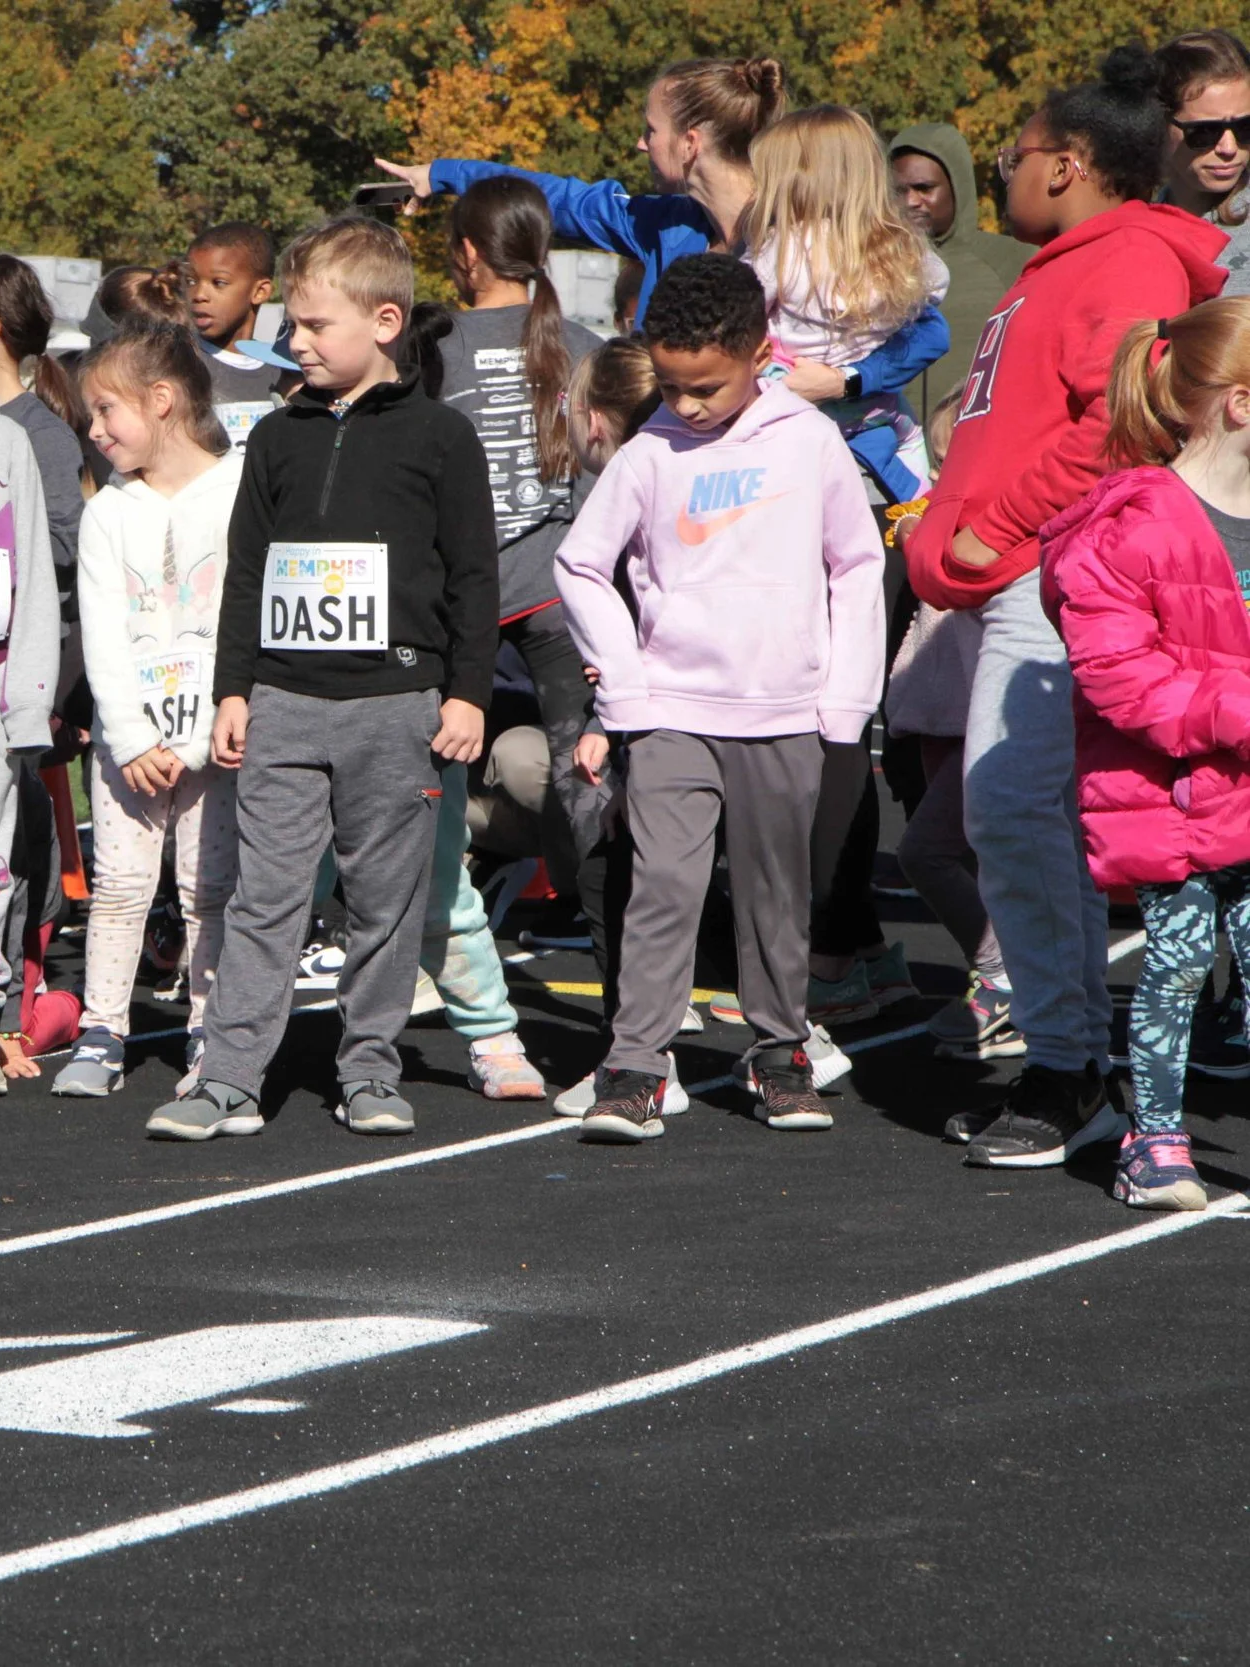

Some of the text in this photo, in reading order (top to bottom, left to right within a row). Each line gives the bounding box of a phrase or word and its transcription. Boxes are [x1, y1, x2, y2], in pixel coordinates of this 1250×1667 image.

[688, 468, 767, 514] NIKE
[276, 559, 367, 577] MEMPHIS
[270, 595, 375, 642] DASH
[140, 660, 195, 684] MPHIS
